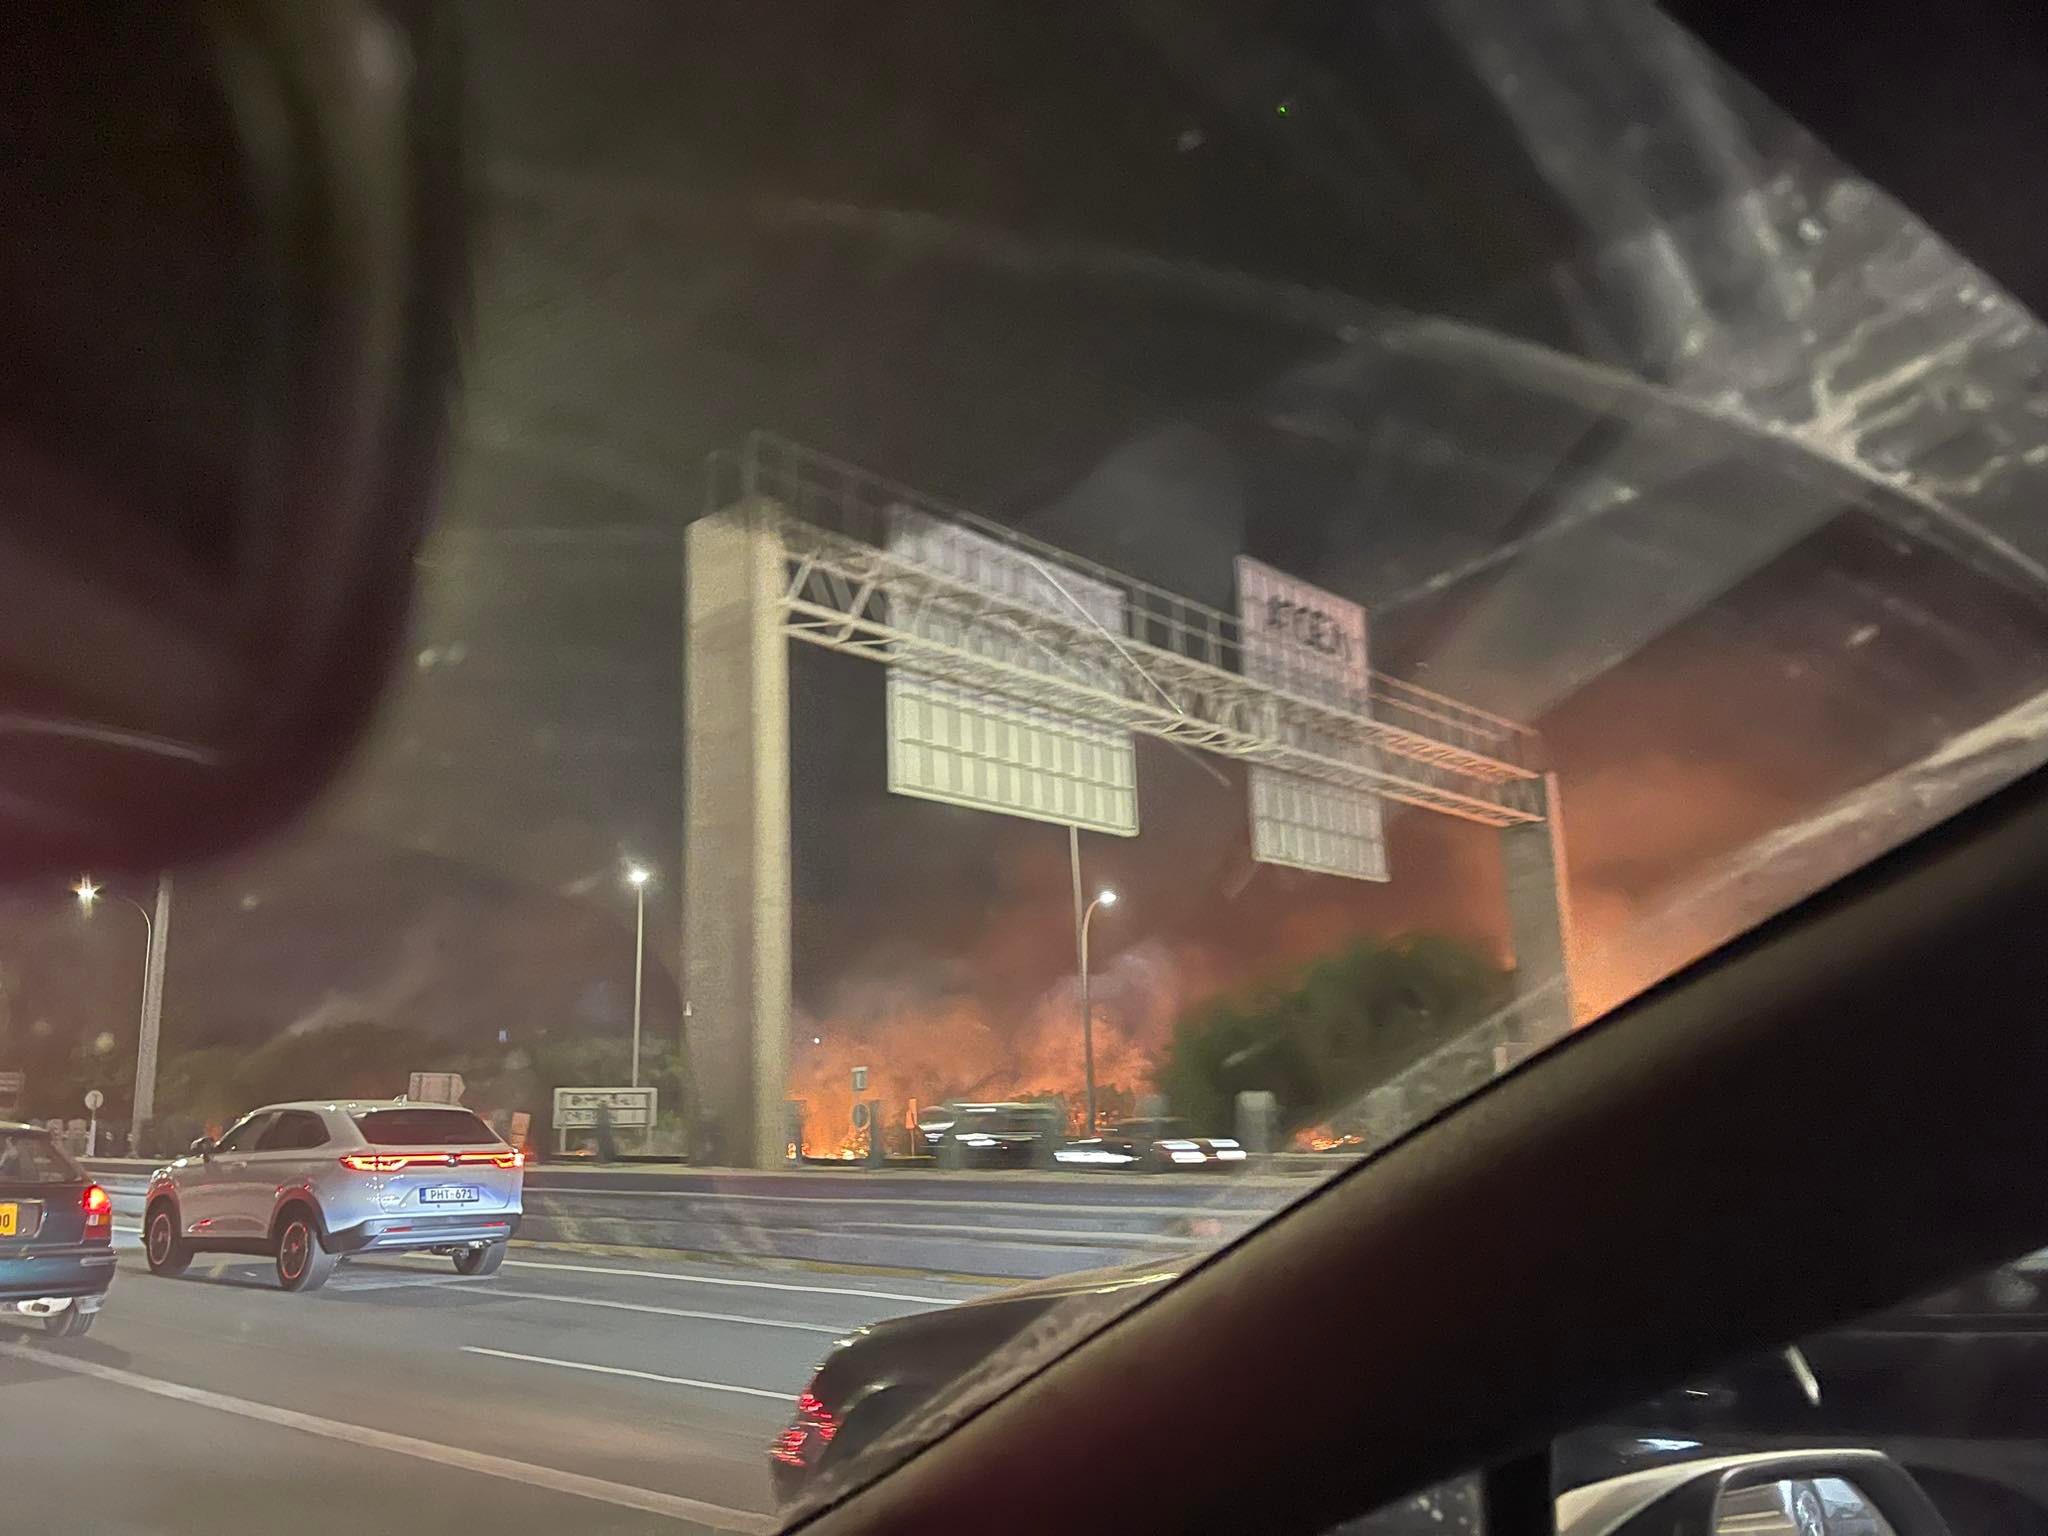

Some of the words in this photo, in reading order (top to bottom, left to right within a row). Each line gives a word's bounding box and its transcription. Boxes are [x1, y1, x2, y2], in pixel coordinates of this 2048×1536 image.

[430, 1189, 449, 1199] PHT
[455, 1188, 472, 1199] 671
[0, 1213, 10, 1228] 0
